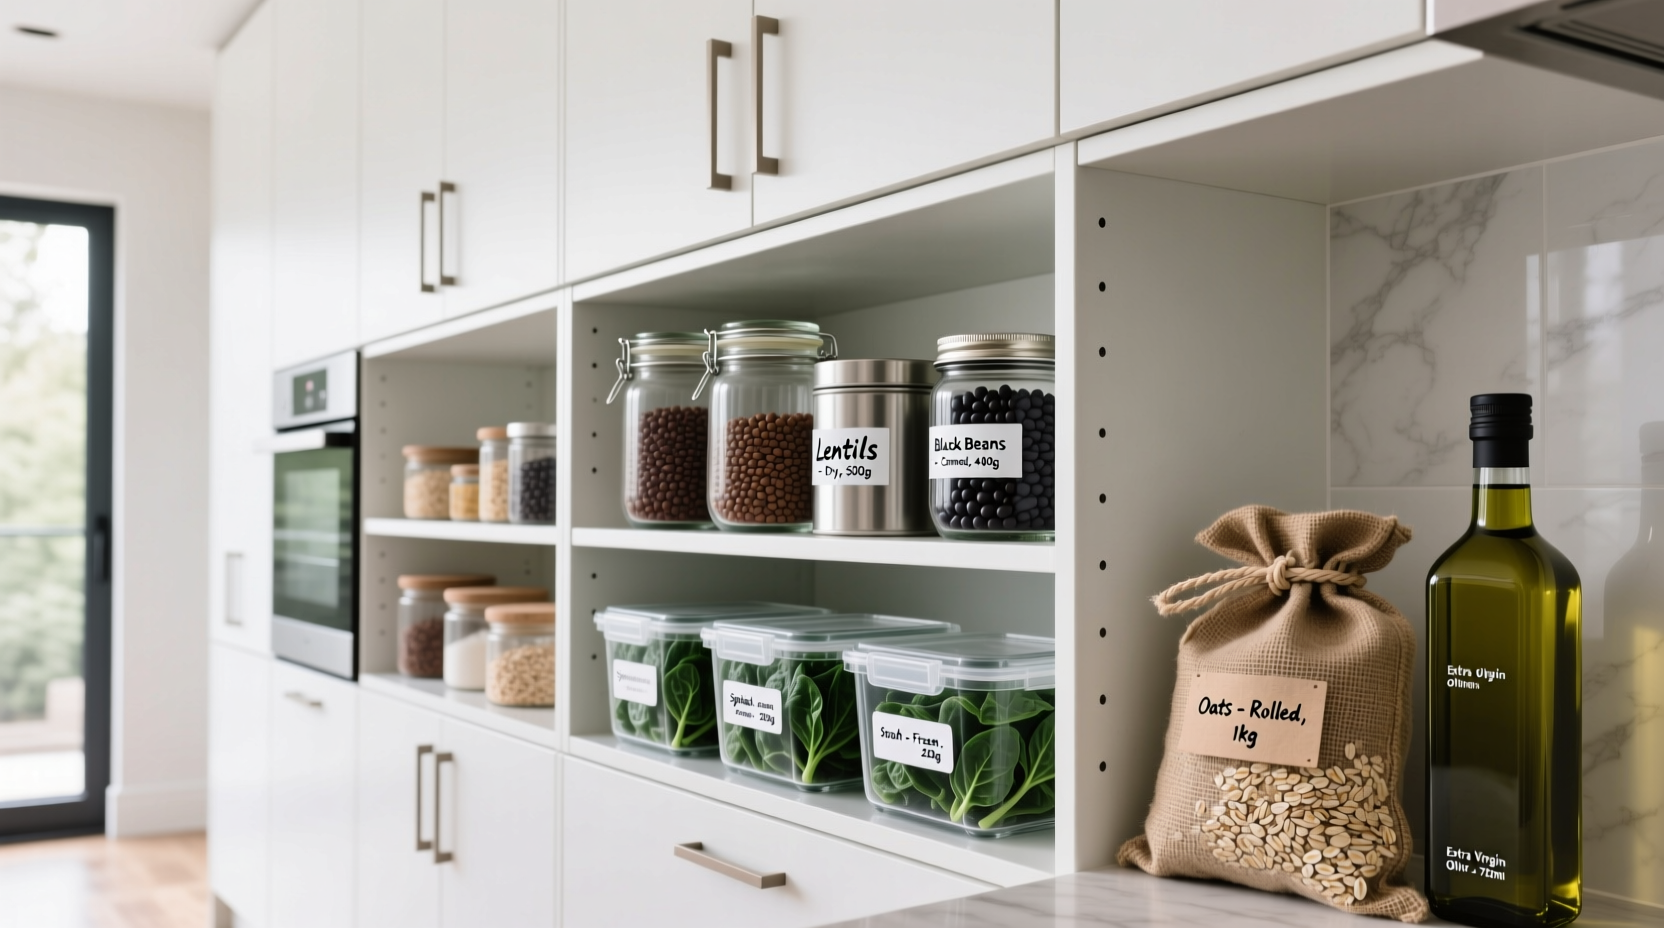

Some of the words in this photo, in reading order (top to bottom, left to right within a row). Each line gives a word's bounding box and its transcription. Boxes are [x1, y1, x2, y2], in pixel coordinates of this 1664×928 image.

[816, 435, 878, 461] Lentils
[965, 437, 1006, 451] Beans
[846, 465, 872, 480] 500g
[974, 456, 999, 470] 400g
[1198, 696, 1233, 717] Oats
[1250, 699, 1306, 726] Rolled,
[1233, 724, 1258, 749] 1kg
